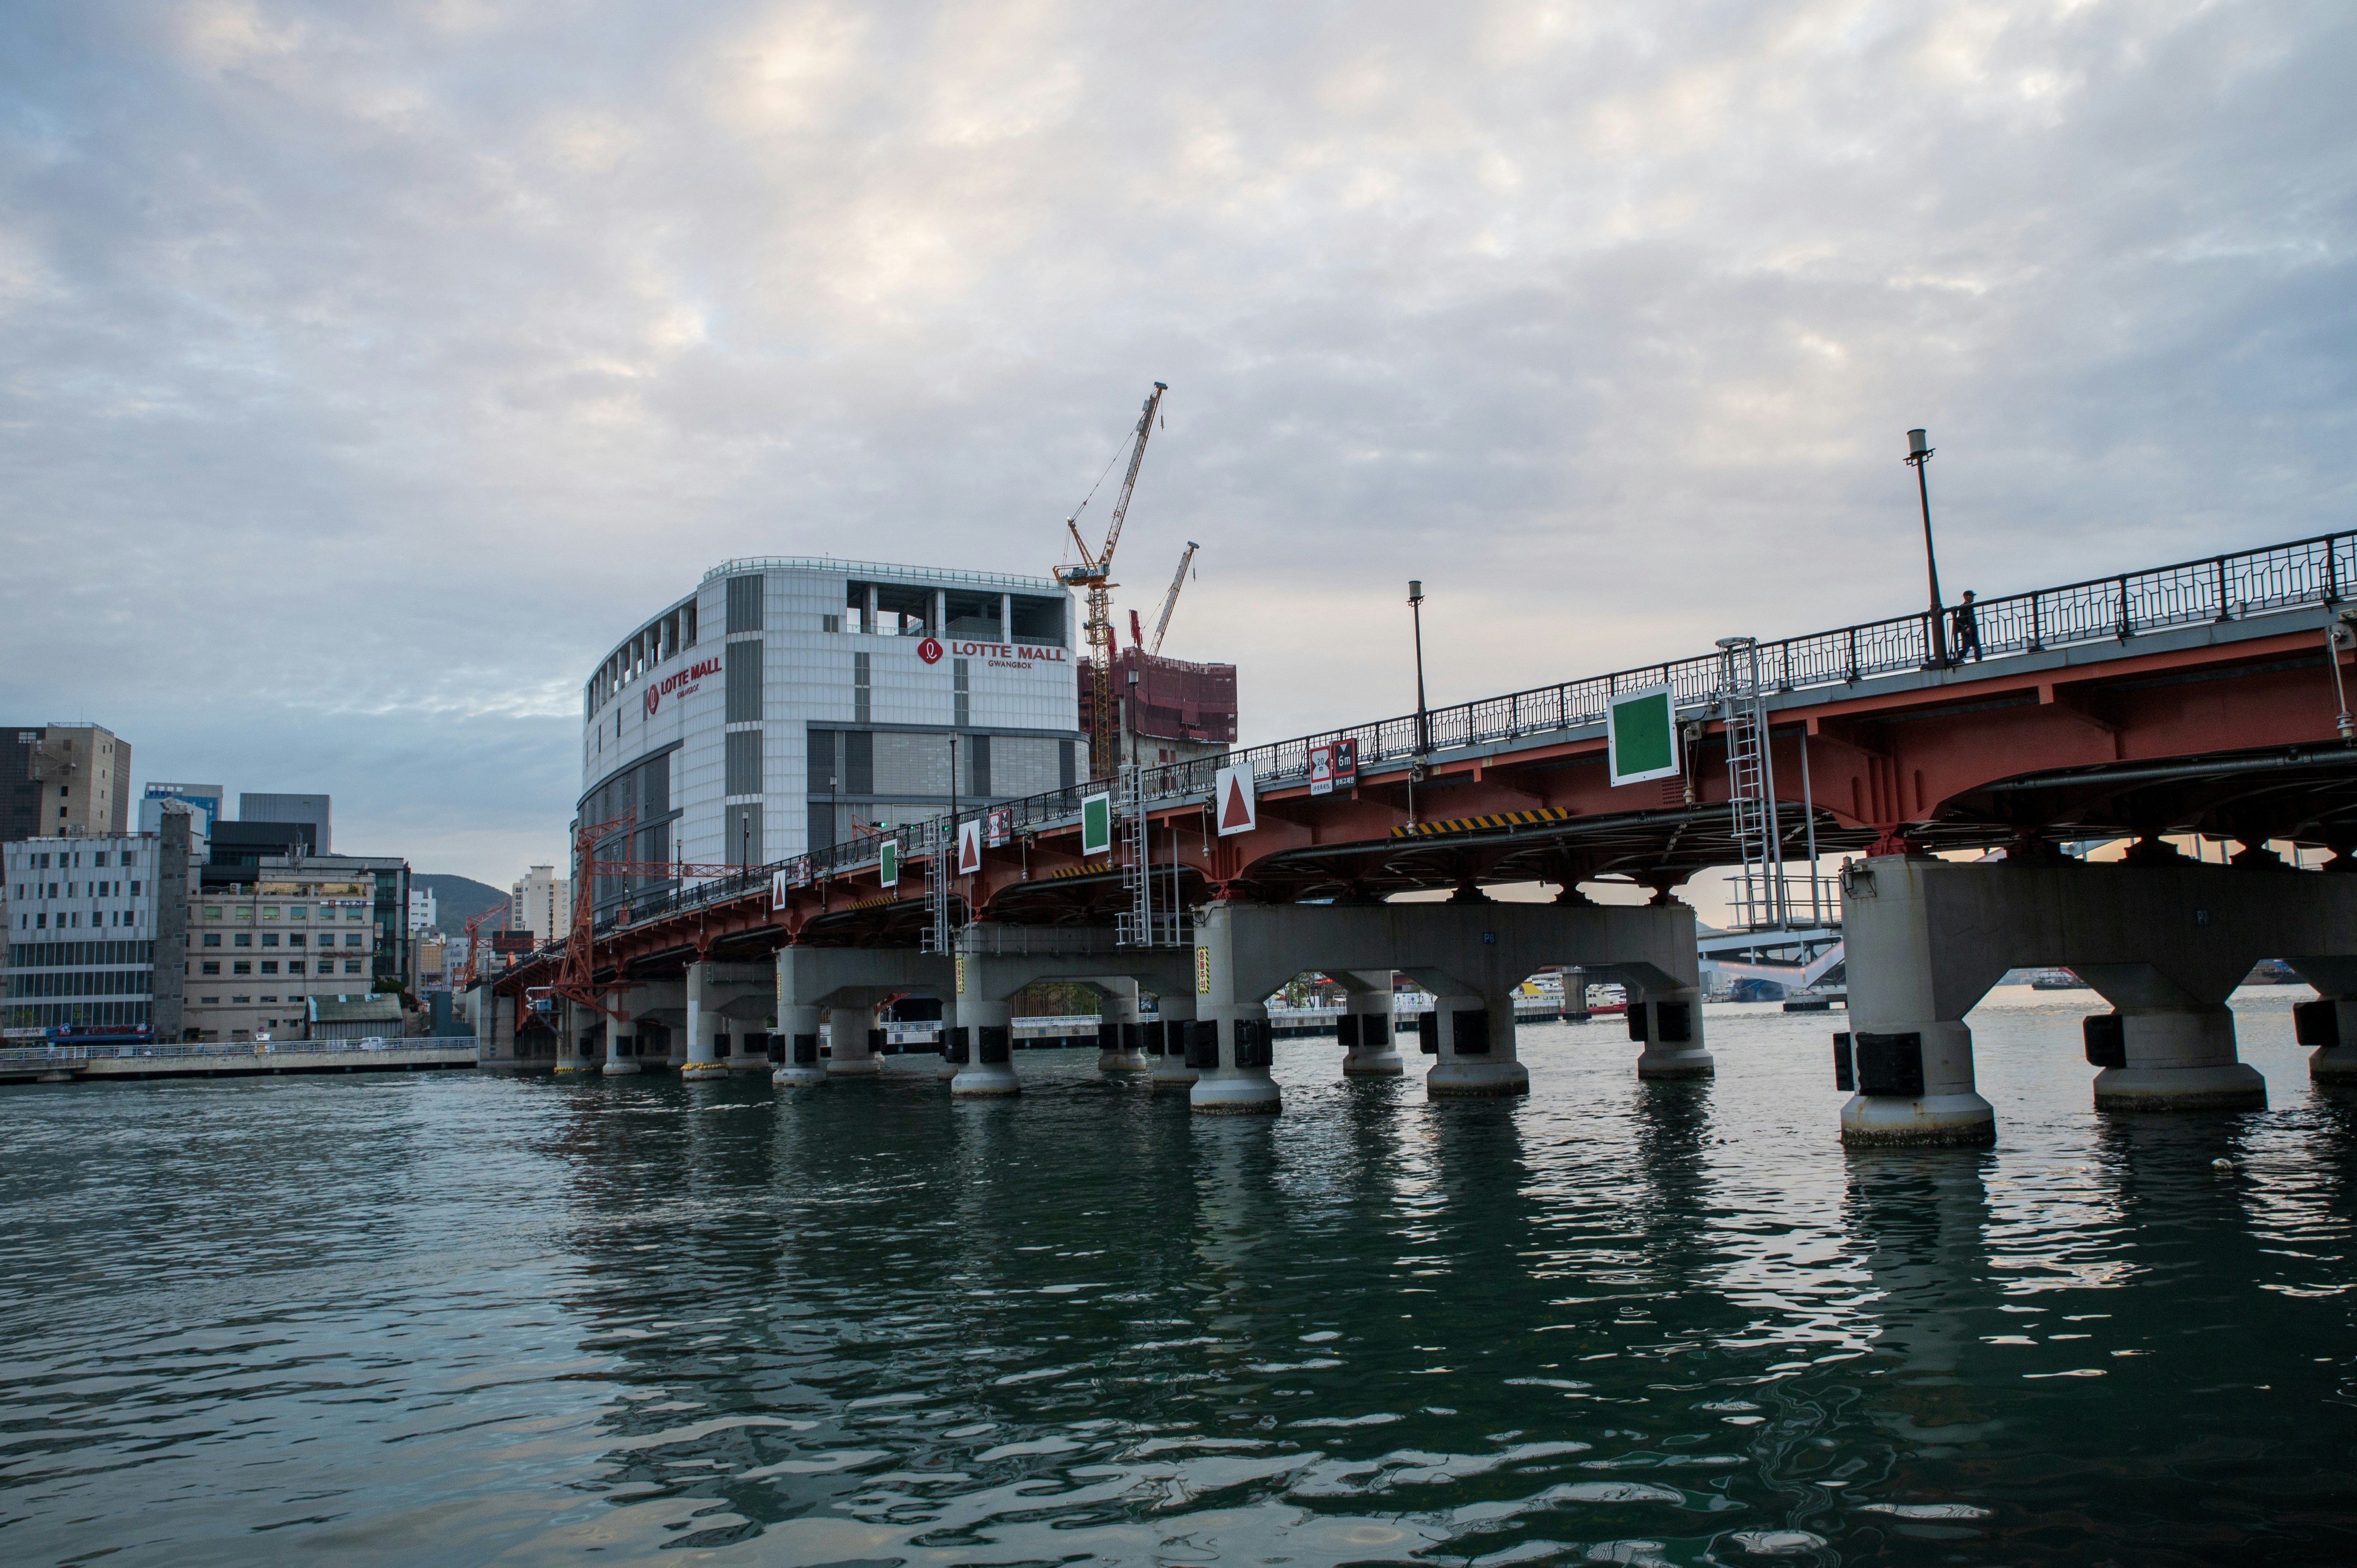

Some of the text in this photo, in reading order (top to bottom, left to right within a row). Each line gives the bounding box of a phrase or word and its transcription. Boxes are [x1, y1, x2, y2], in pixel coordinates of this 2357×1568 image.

[953, 642, 1066, 662] LOTTE MALL
[988, 660, 1032, 669] GWANGBOK
[661, 657, 722, 695] LOTTE MALL
[677, 683, 699, 700] GWANGBOK
[1317, 757, 1324, 766] 20
[1338, 755, 1351, 767] 6m
[1002, 820, 1008, 829] 7m
[1484, 933, 1494, 943] P6
